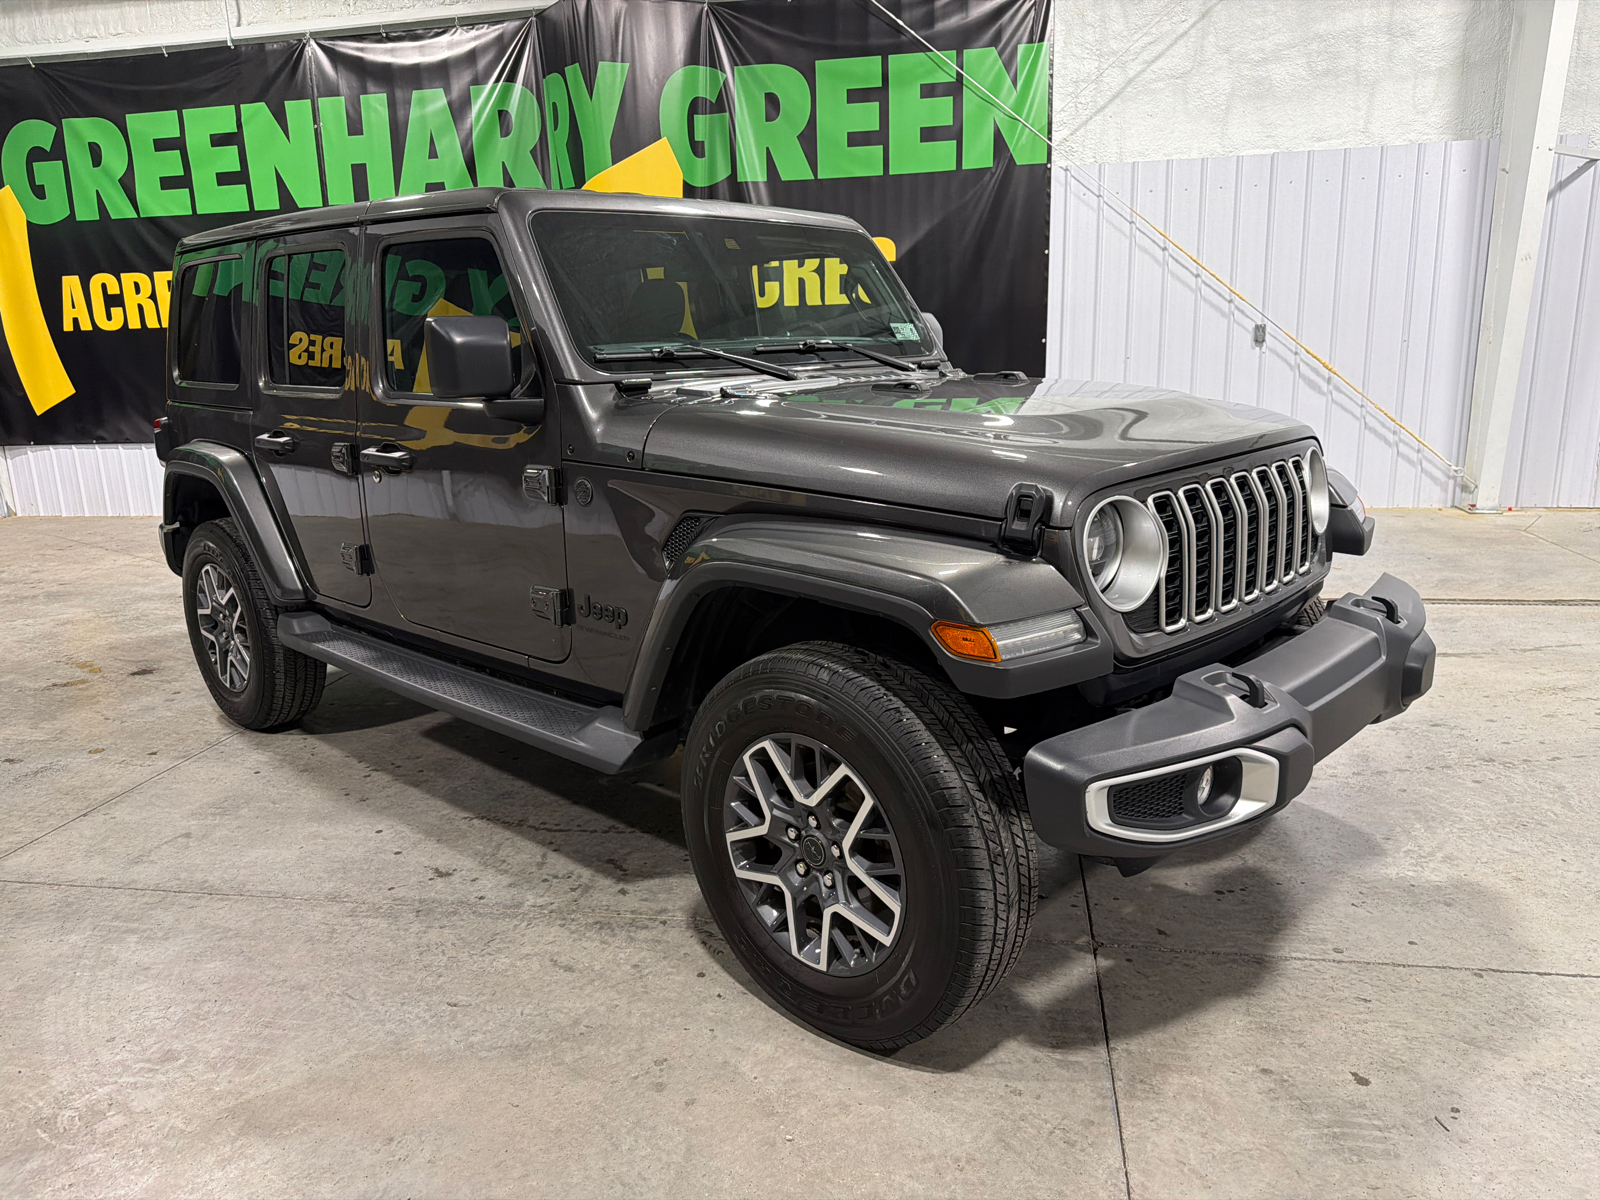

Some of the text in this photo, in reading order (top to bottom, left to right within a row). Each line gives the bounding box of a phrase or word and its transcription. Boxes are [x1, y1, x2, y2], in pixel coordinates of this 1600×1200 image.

[659, 42, 1050, 187] GREEN
[62, 271, 173, 332] ACRE
[577, 594, 629, 630] Jeep
